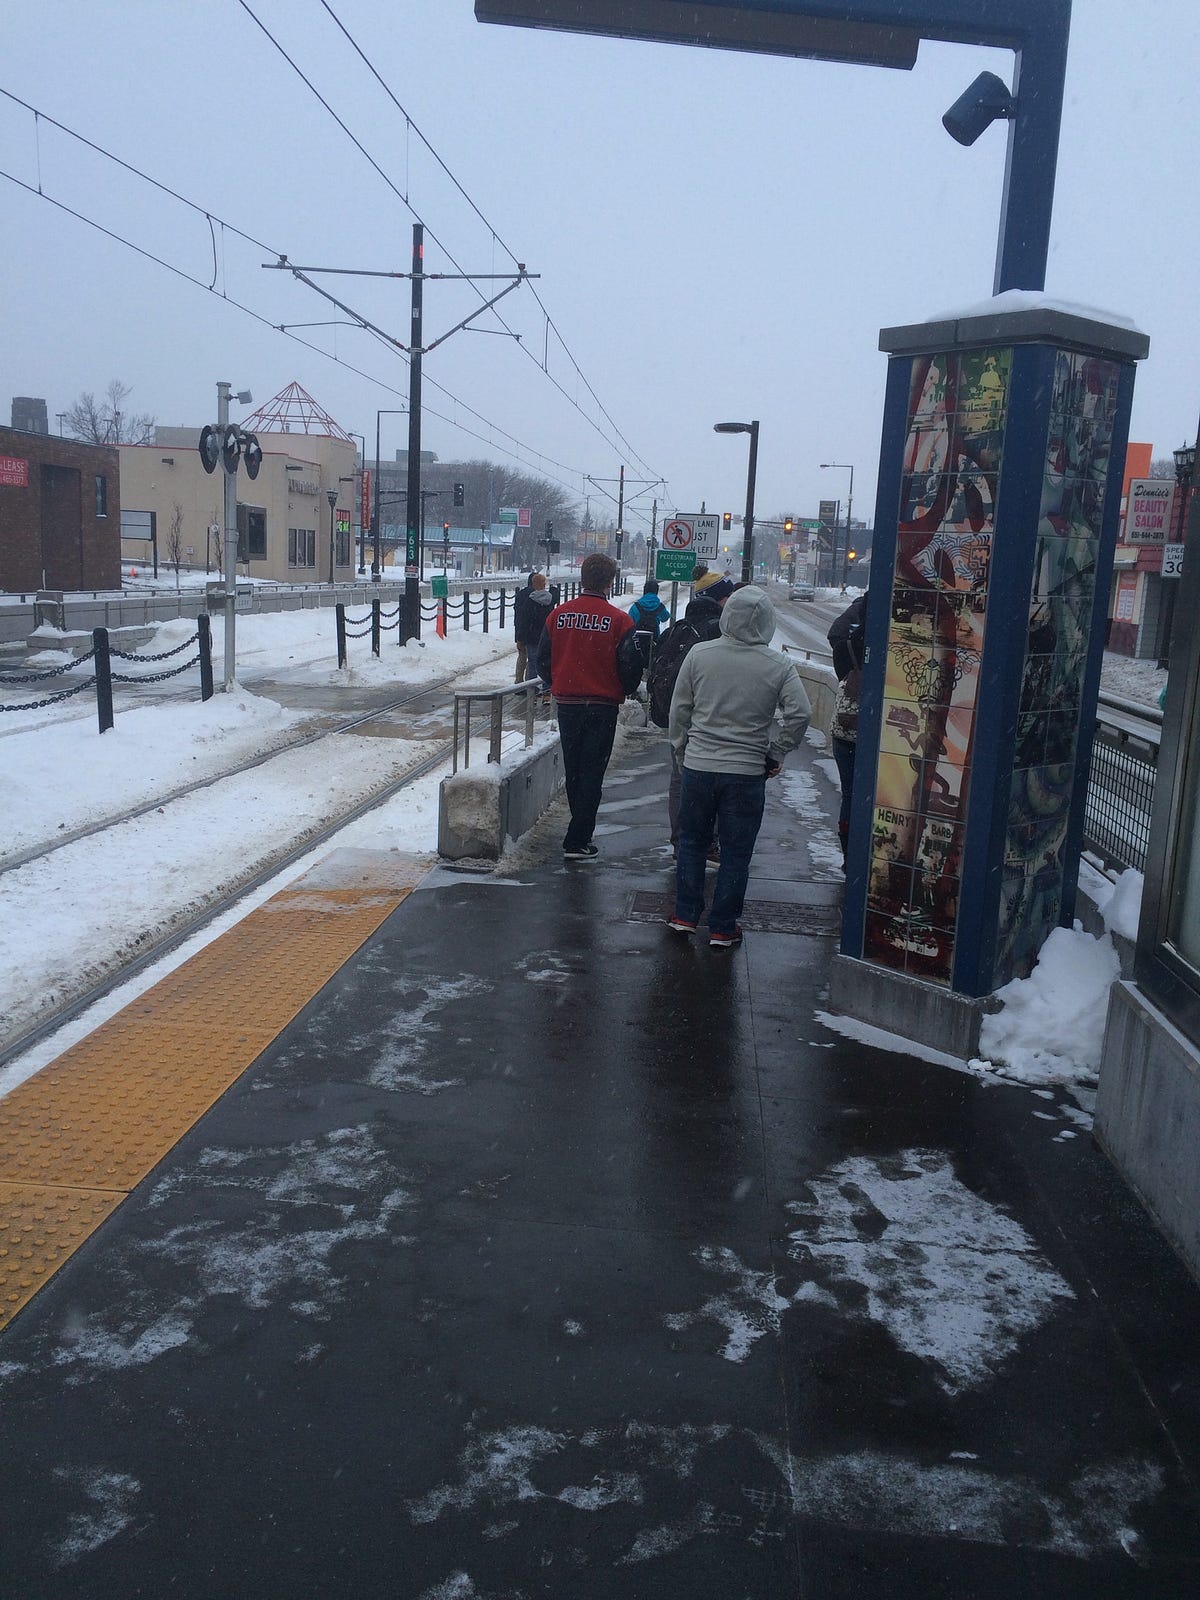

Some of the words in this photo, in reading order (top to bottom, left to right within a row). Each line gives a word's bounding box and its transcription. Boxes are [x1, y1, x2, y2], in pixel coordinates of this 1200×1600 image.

[3, 459, 25, 473] LEASE
[1133, 499, 1168, 514] BEAUTY
[697, 520, 715, 528] LANE
[1135, 514, 1164, 529] SALON
[692, 532, 708, 542] UST
[697, 546, 714, 554] LEFT
[556, 612, 612, 633] STILLS
[877, 808, 912, 828] HENRY
